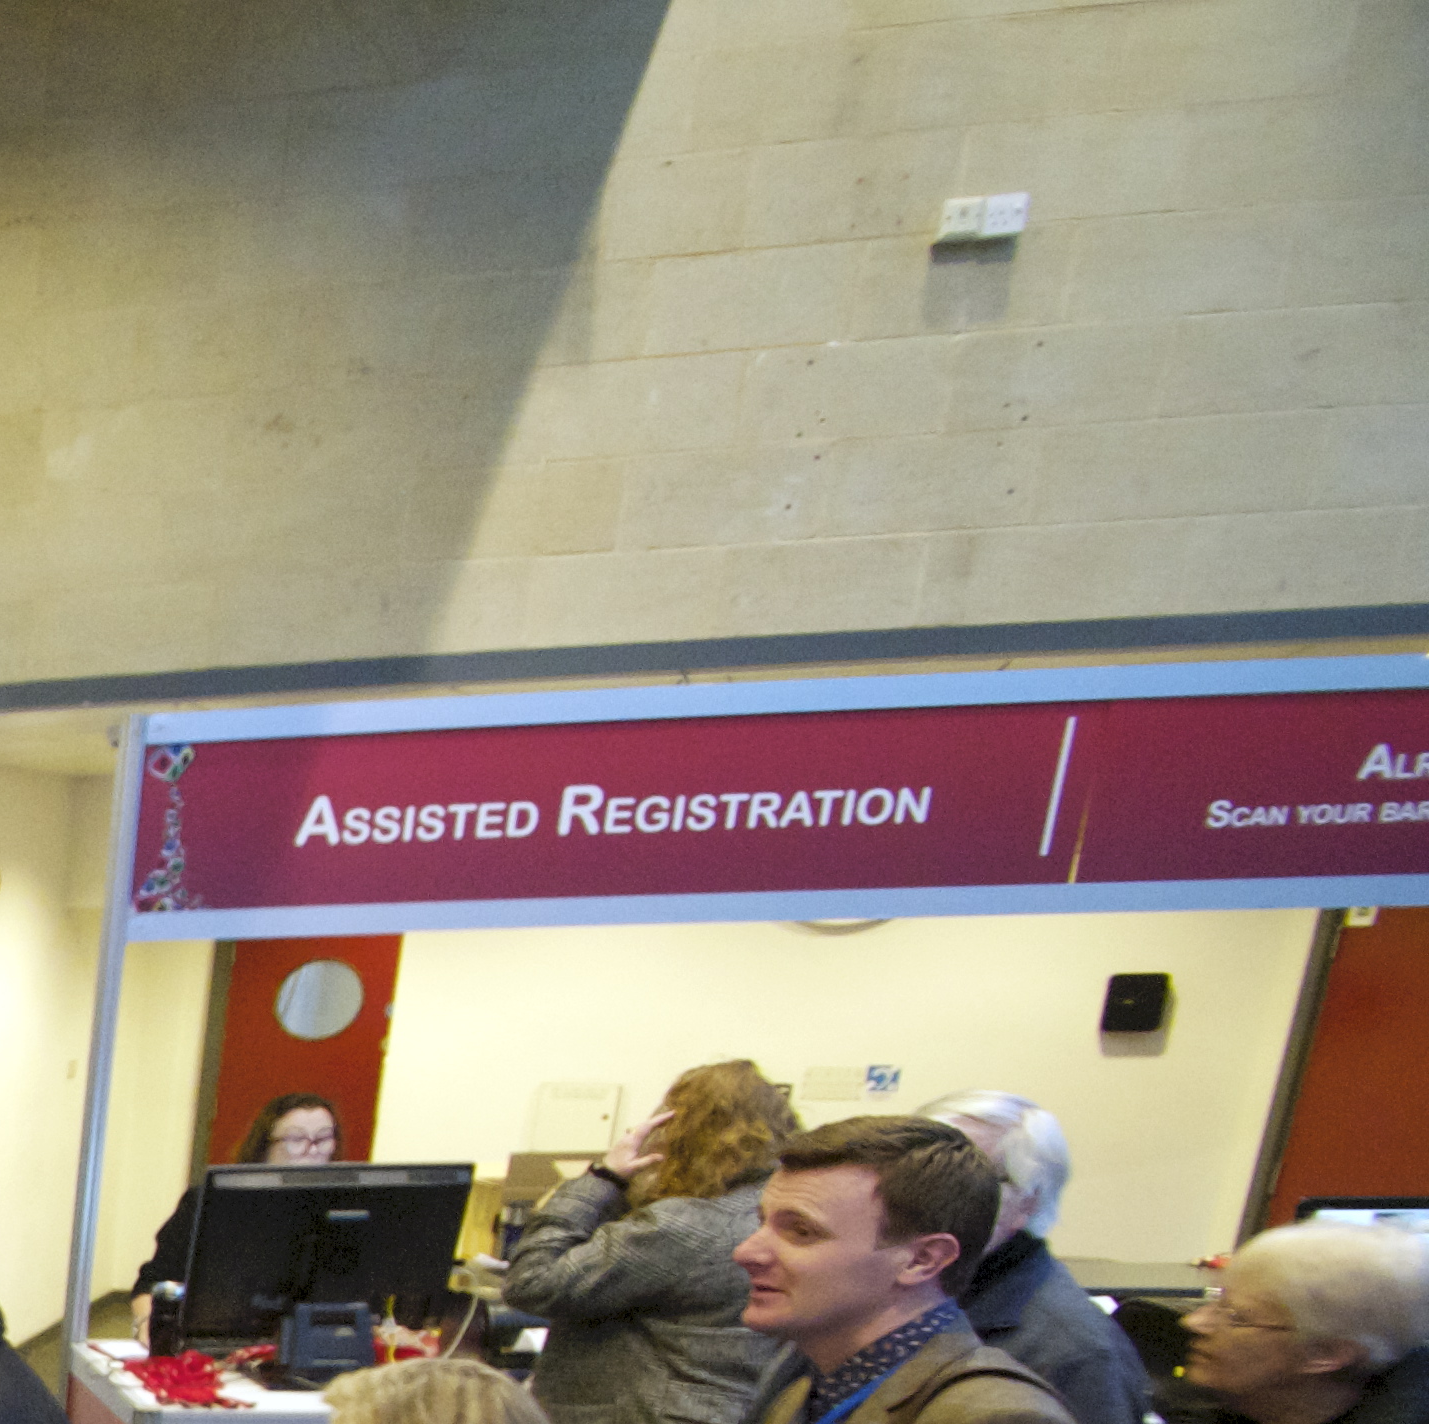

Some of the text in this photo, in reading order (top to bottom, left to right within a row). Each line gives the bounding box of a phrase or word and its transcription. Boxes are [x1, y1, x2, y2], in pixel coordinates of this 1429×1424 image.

[294, 783, 933, 847] ASSISTED REGISTRATION
[1206, 799, 1289, 828] SCAN
[1296, 803, 1372, 824] YOUR
